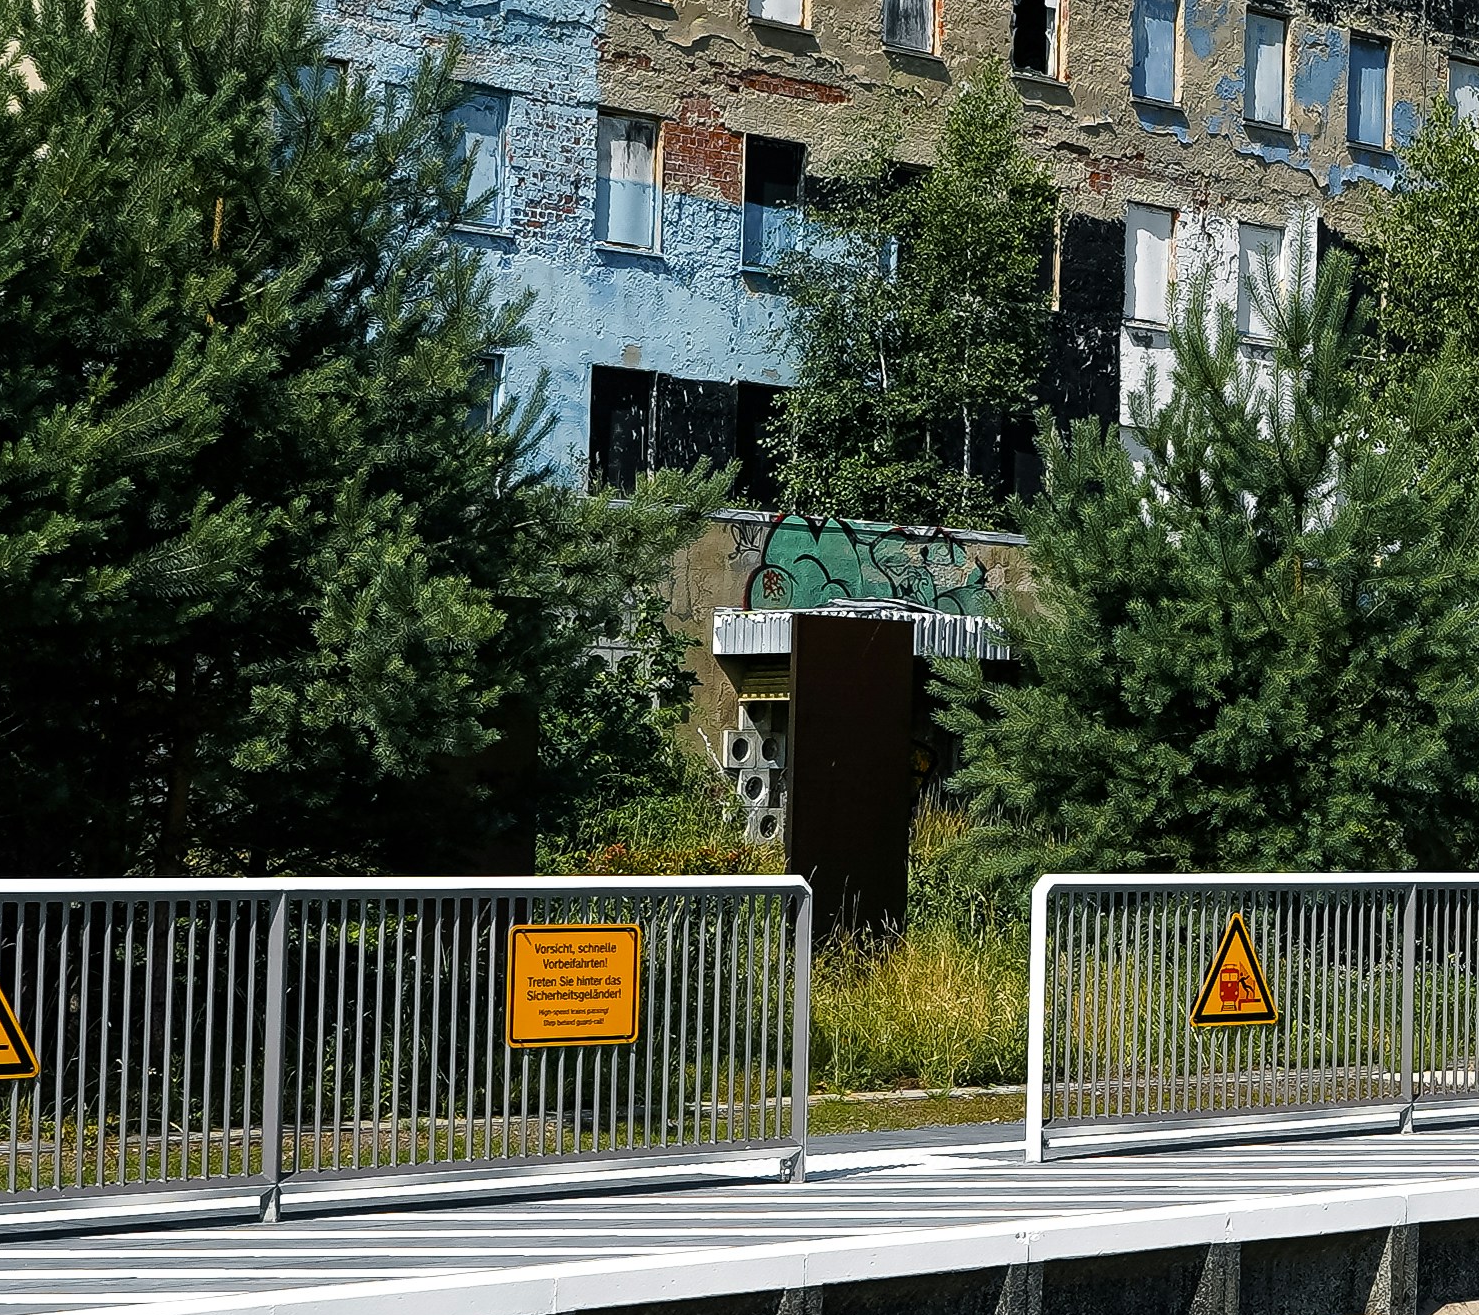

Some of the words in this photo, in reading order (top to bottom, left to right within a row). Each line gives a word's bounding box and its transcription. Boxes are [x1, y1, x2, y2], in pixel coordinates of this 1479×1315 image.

[534, 943, 576, 955] Vorsicht,
[577, 942, 617, 954] schnelle
[542, 958, 608, 969] Vorbeifahrten!
[527, 977, 557, 988] Treten
[559, 976, 574, 987] Sie
[576, 975, 602, 987] hinter
[604, 975, 622, 986] das
[526, 988, 622, 1002] Sicherheitsgeländer!
